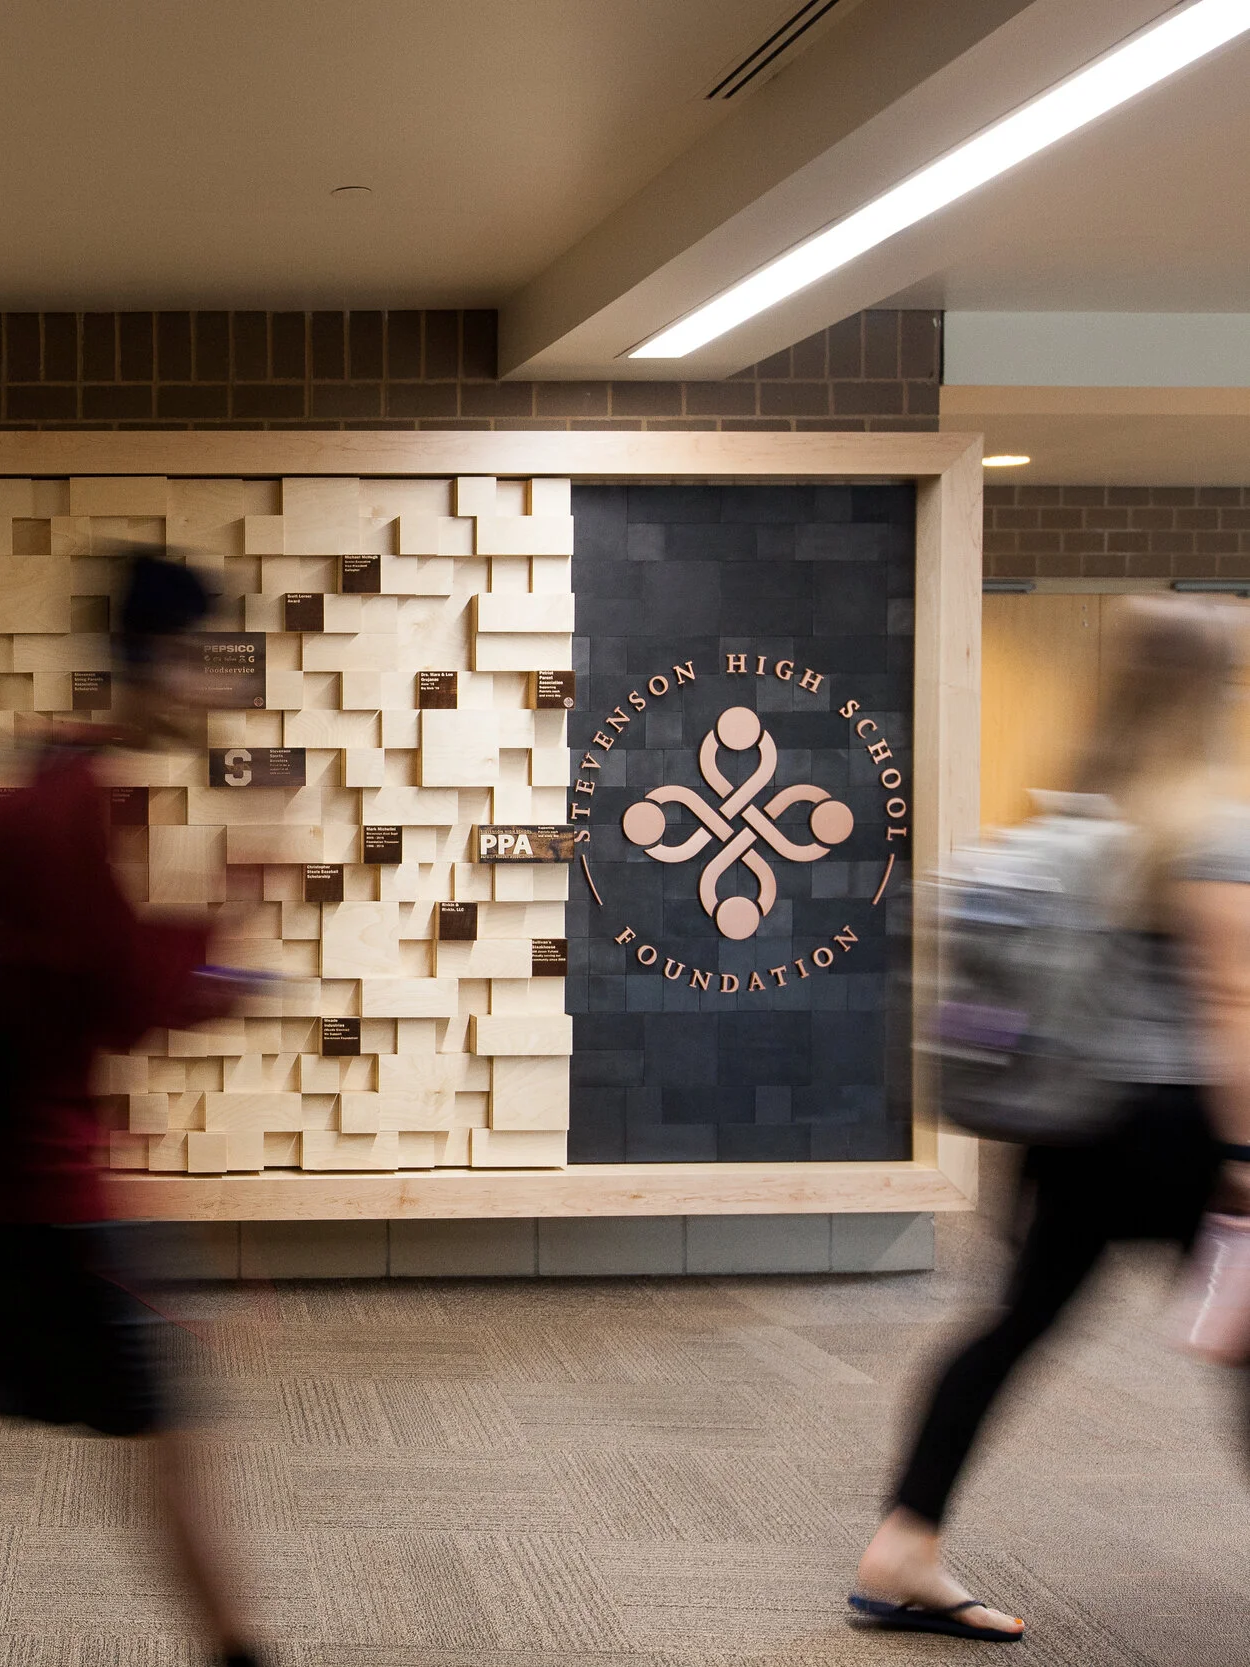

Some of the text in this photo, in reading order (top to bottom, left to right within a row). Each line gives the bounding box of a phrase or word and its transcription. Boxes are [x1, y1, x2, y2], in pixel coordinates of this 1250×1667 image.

[224, 749, 252, 786] S
[571, 654, 907, 842] STEVENSON HIGH SCHOOL
[481, 834, 533, 854] PPA
[615, 925, 859, 993] FOUNDATION
